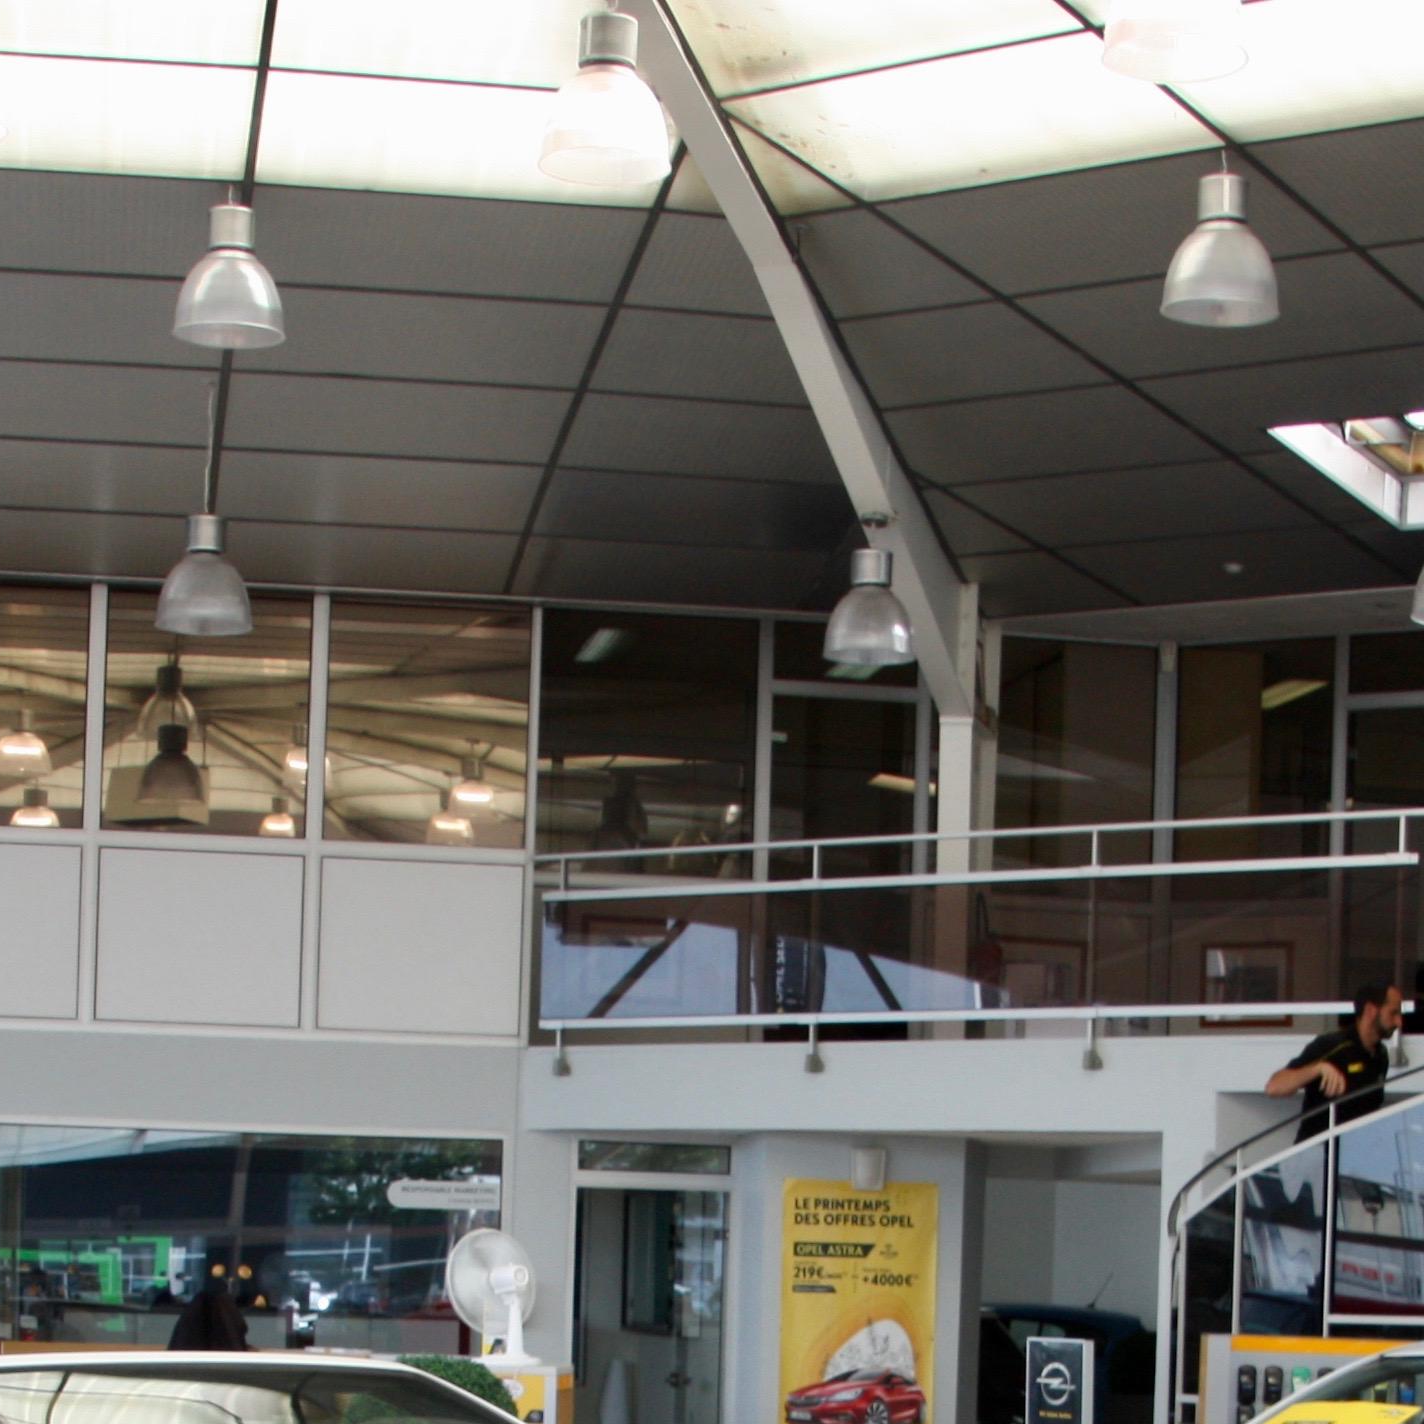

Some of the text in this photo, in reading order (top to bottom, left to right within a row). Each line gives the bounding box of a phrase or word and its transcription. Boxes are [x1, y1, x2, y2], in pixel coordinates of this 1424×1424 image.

[794, 1198, 891, 1212] LE PRINTEMPS
[794, 1213, 914, 1228] DES OFFRES OPEL
[796, 1244, 864, 1256] OPEL ASTRA
